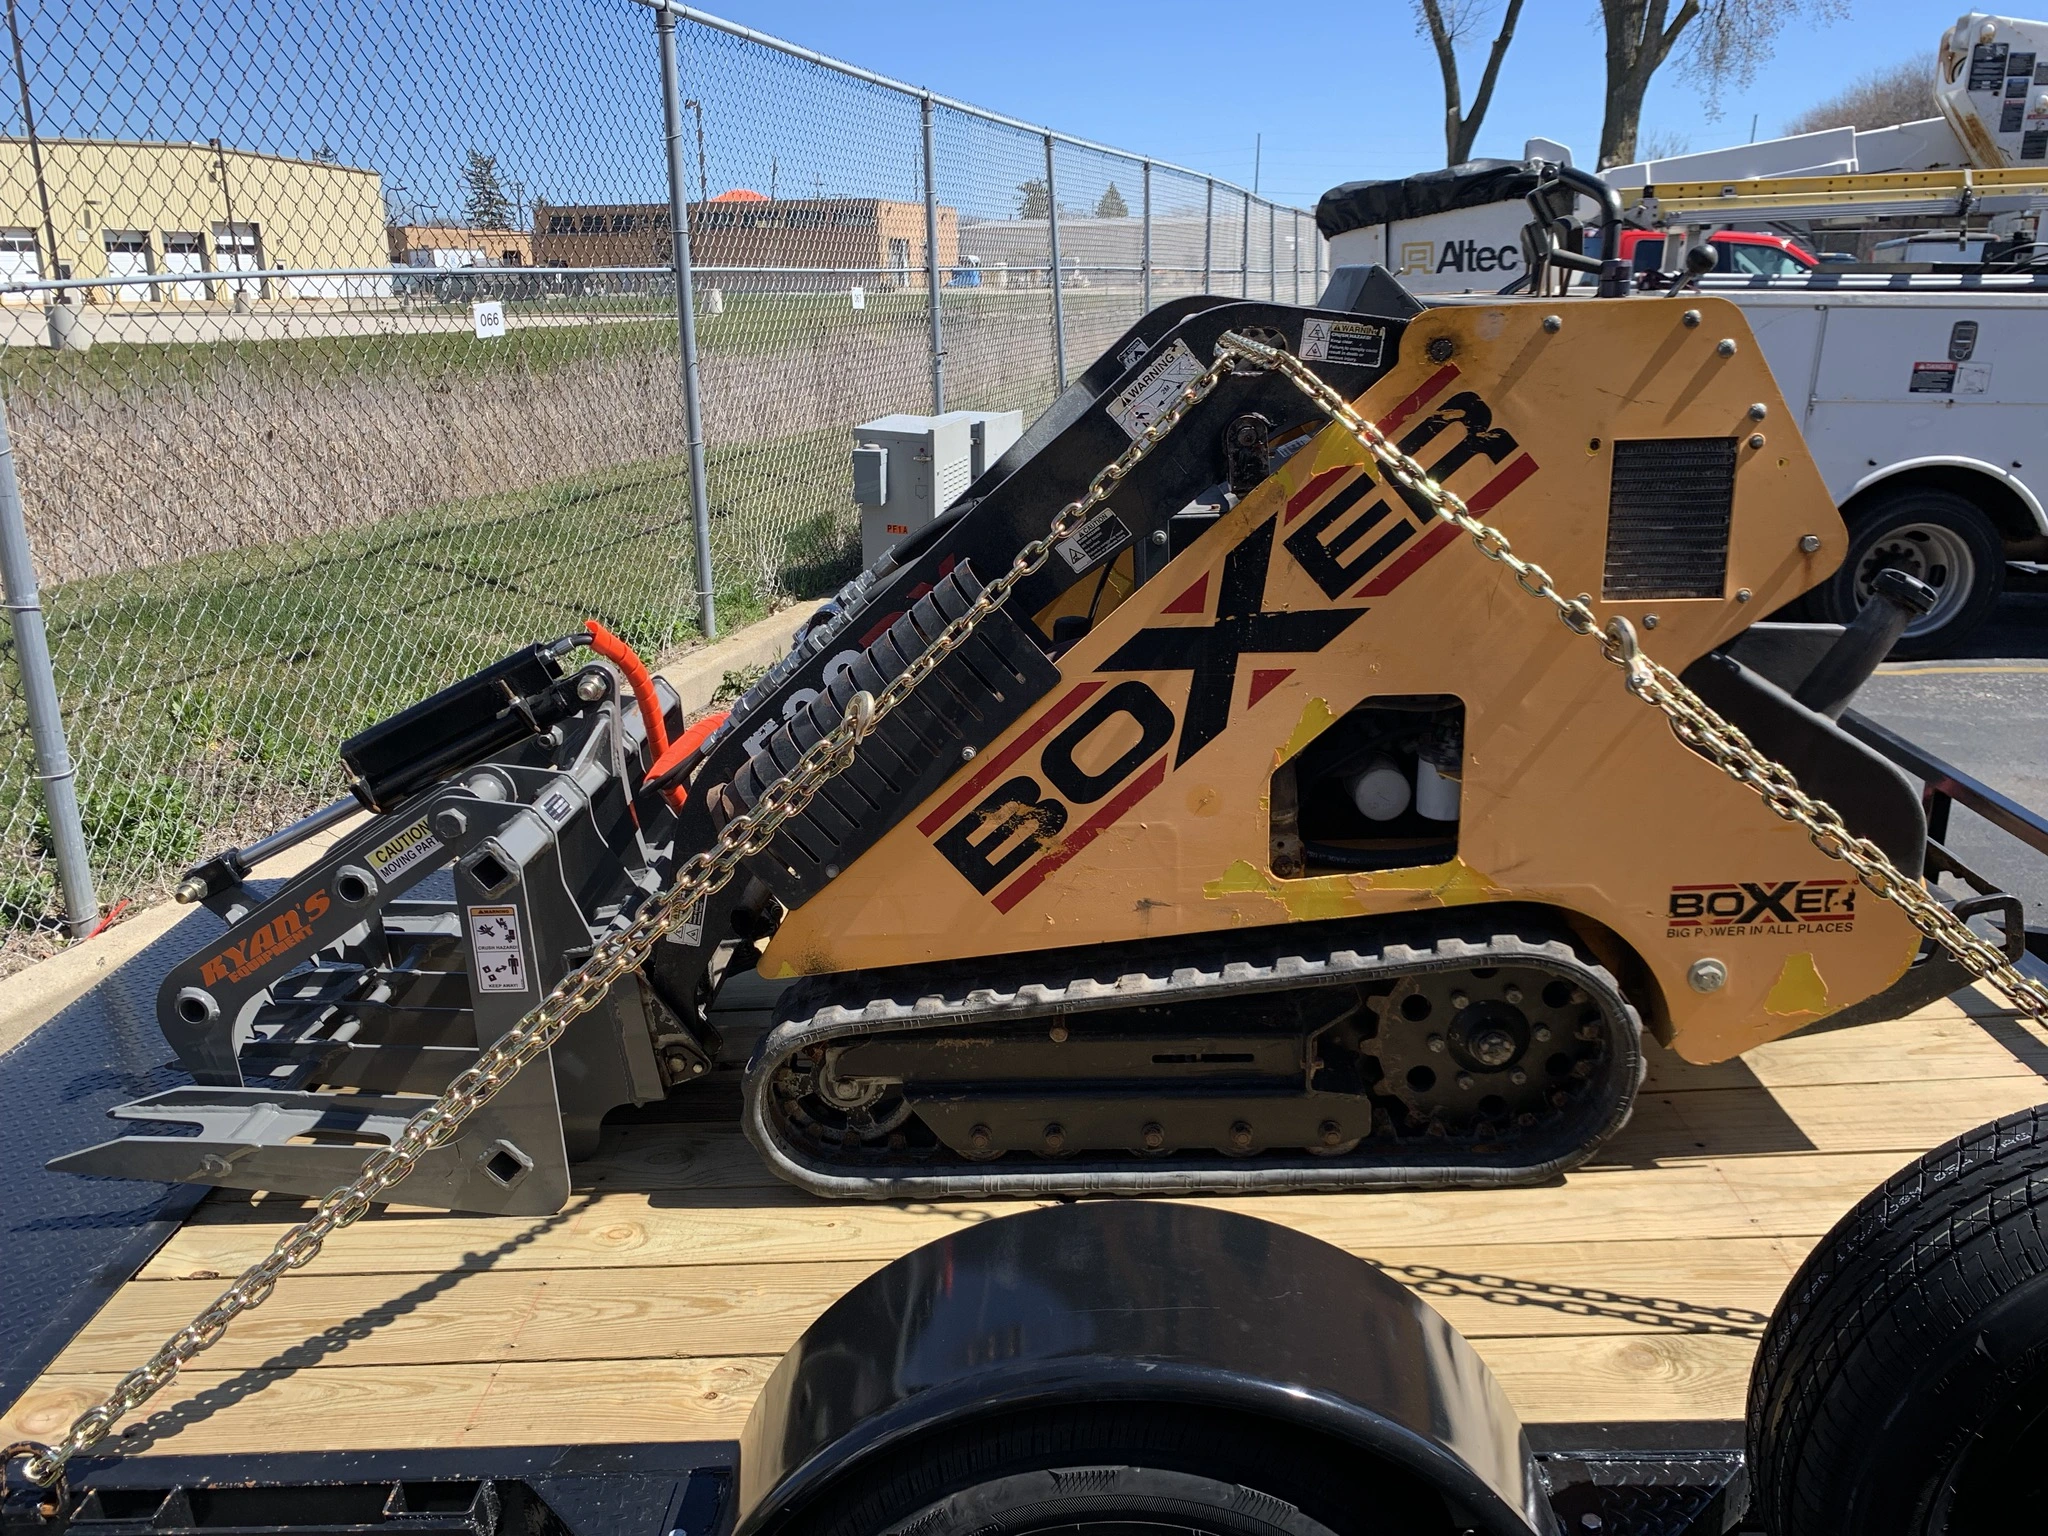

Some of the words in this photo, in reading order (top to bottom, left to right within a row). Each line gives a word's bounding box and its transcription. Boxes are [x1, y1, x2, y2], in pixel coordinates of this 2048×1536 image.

[1436, 239, 1518, 274] Altec
[480, 312, 500, 327] 066
[1342, 325, 1379, 335] WARNIN
[1128, 353, 1175, 398] WARNING
[1161, 385, 1171, 395] 2M
[1083, 513, 1108, 534] CAUTION
[933, 391, 1519, 896] BOXER
[375, 820, 430, 863] CAUTION
[380, 850, 417, 878] MOVING
[1668, 881, 1856, 924] BOXER
[1666, 928, 1690, 938] BIG
[1750, 925, 1764, 935] IN
[1767, 924, 1793, 935] ALL
[1797, 922, 1853, 933] PLACES
[228, 924, 314, 984] EQUIPMENT
